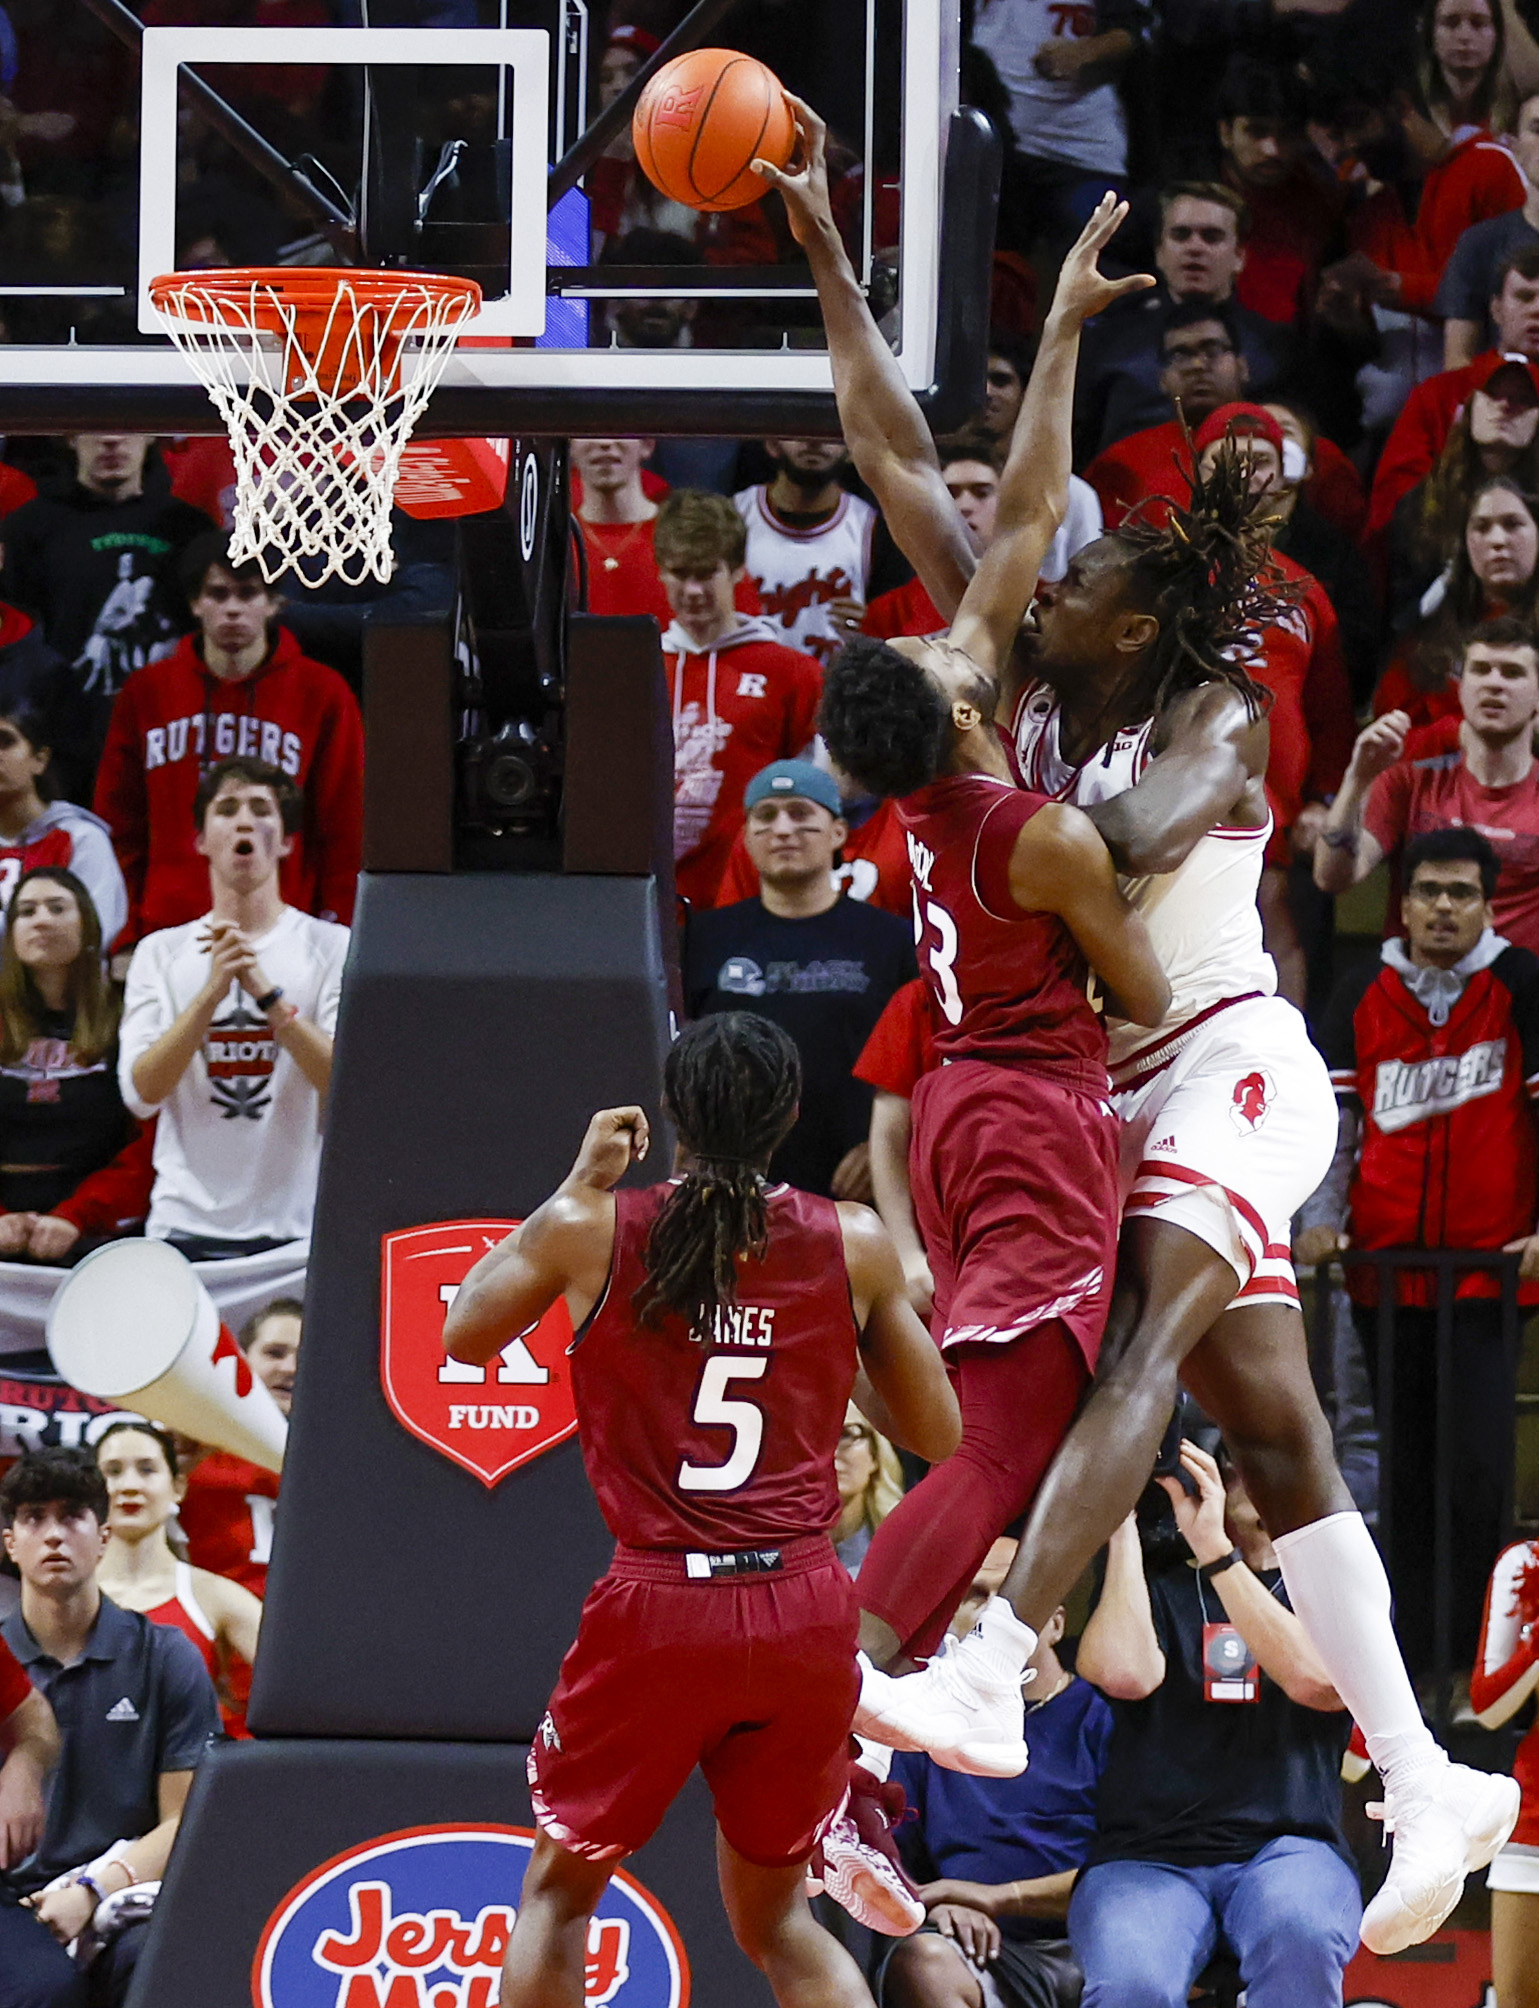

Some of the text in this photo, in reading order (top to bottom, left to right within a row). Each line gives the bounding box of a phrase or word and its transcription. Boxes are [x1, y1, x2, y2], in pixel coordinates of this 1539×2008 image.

[655, 85, 706, 132] R
[736, 673, 768, 698] R
[145, 712, 302, 776] RUTGERS
[1374, 1039, 1506, 1114] RUTGERS
[448, 1405, 540, 1429] FUND
[678, 1355, 768, 1491] 5
[1223, 1639, 1240, 1658] S
[315, 1884, 626, 2000] Jersy
